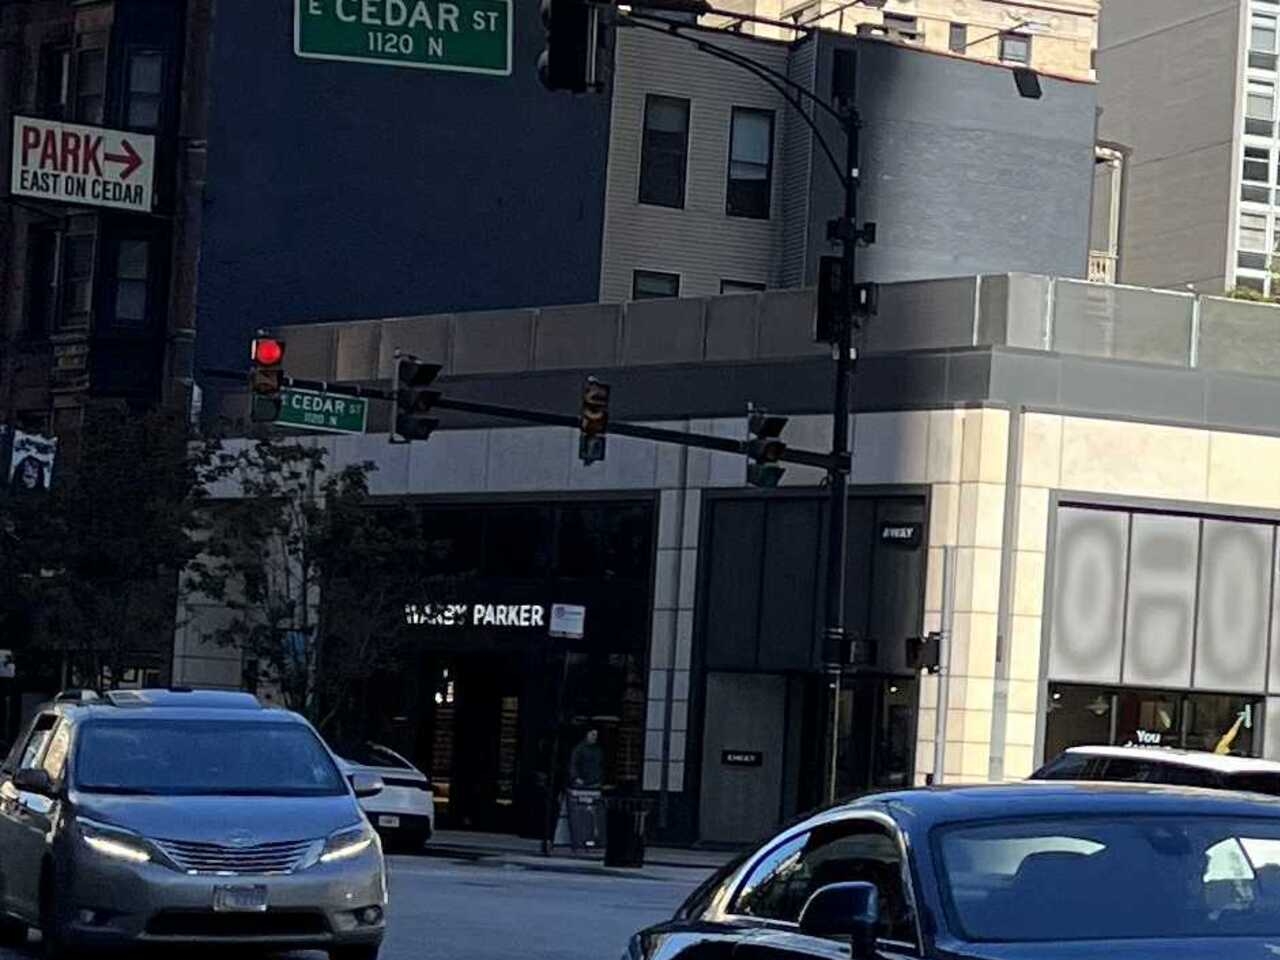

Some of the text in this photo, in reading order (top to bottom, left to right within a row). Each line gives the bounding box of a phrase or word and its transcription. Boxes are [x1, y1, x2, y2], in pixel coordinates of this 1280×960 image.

[308, 0, 499, 32] E CEDAR ST
[367, 32, 444, 57] 1120 N
[21, 125, 104, 177] PARK
[20, 169, 144, 205] EAST ON CEDAR
[291, 394, 345, 414] CEDAR
[472, 603, 545, 627] PARKER
[1136, 729, 1161, 744] You
